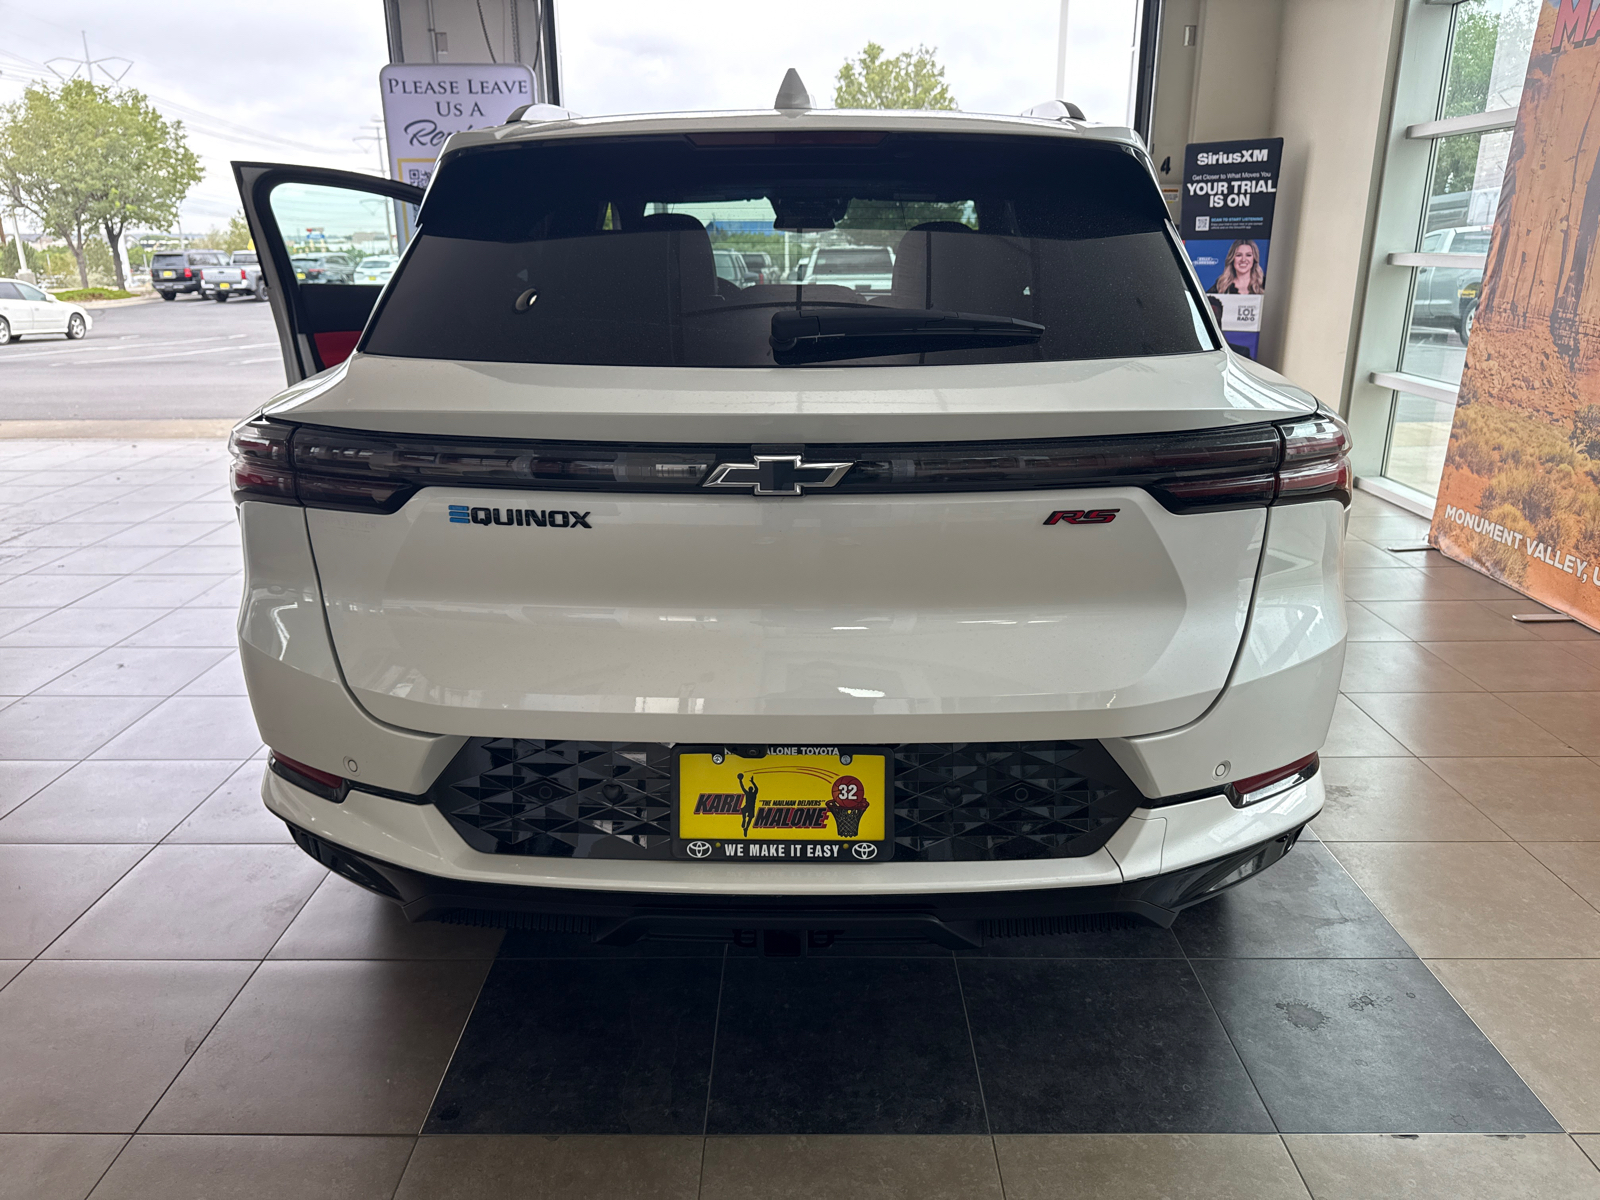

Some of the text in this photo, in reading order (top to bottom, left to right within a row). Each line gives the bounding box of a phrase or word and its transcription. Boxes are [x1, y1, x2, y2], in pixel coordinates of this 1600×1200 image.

[387, 77, 529, 95] PLEASE LEAVE
[435, 101, 486, 118] US A
[1160, 156, 1172, 175] 4
[1197, 149, 1268, 166] SiriusXM
[1187, 181, 1228, 196] YOUR
[1231, 179, 1277, 194] TRIAL
[1209, 193, 1250, 208] IS ON
[1237, 308, 1256, 317] LOL
[448, 505, 592, 529] EQUINOX
[1043, 508, 1120, 525] RS
[1444, 504, 1523, 550] MONUMENT
[1526, 537, 1588, 583] VALLEY,
[765, 747, 840, 756] ALONE TOYOTA
[838, 784, 858, 800] 32
[694, 793, 745, 815] KARL
[752, 807, 829, 829] MALONE
[724, 844, 840, 857] WE MAKE IT EASY
